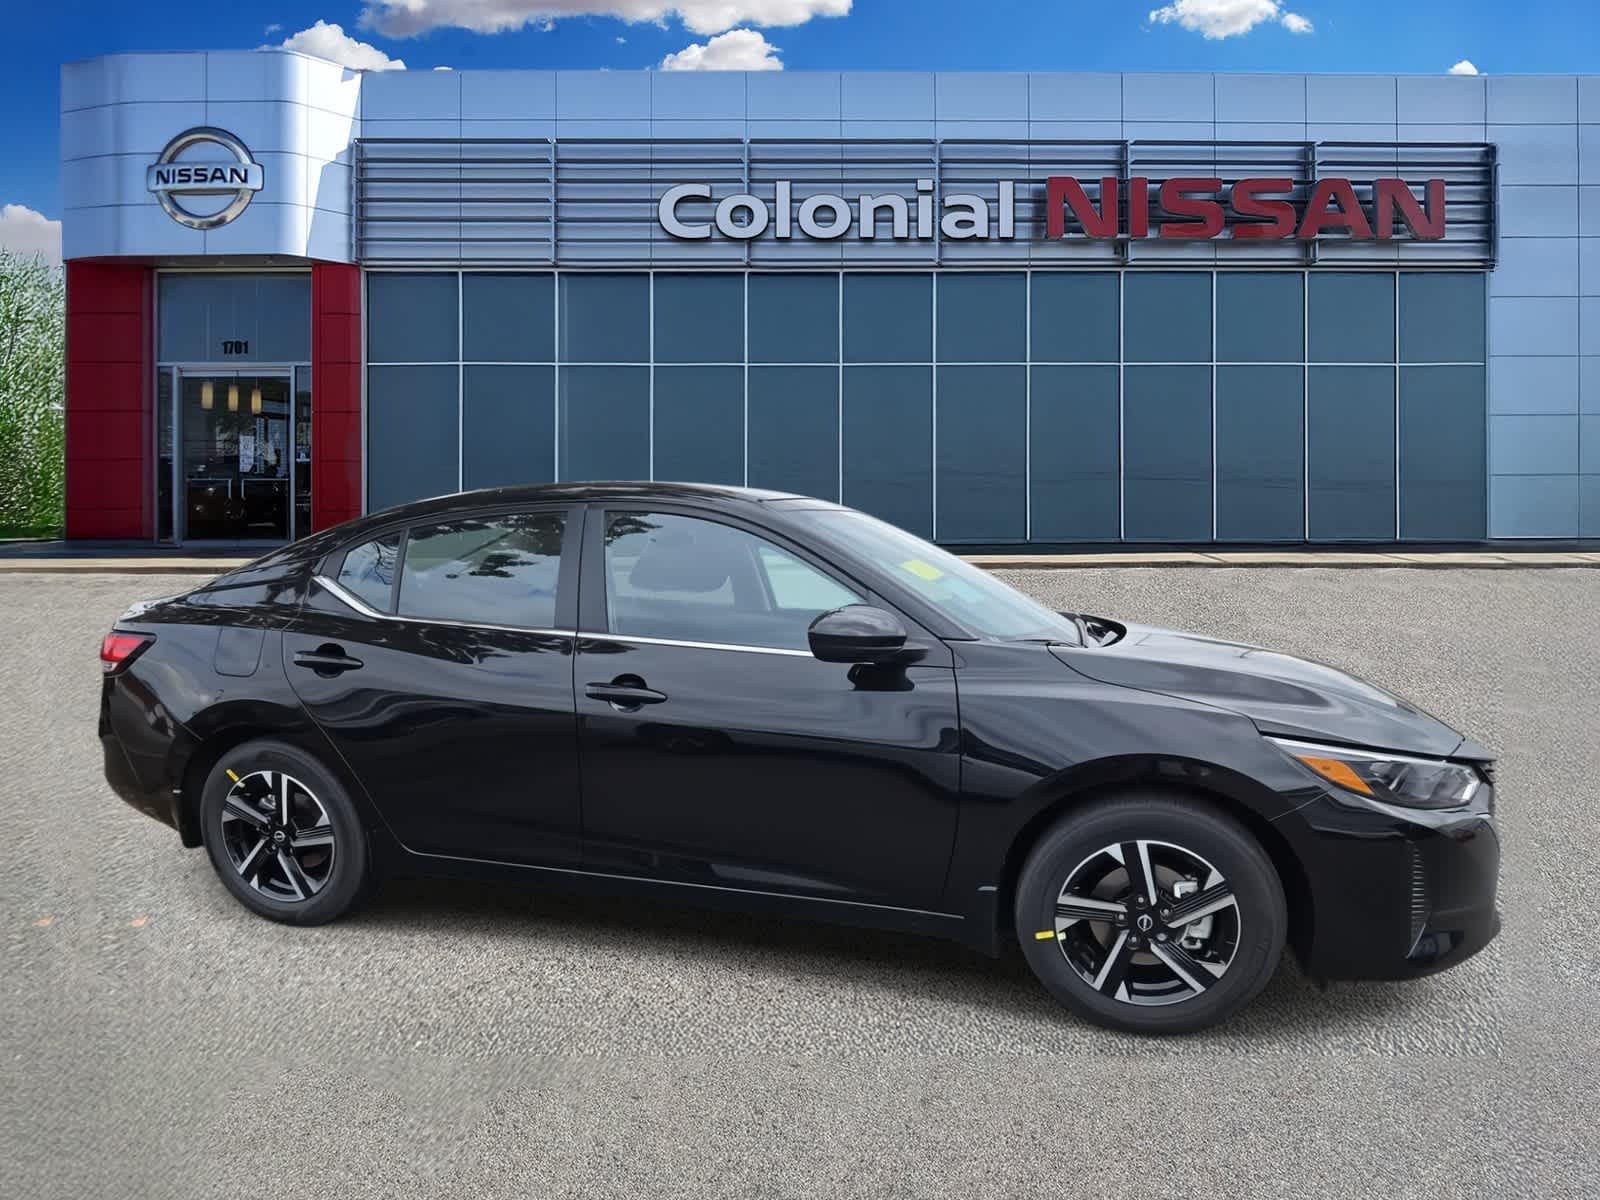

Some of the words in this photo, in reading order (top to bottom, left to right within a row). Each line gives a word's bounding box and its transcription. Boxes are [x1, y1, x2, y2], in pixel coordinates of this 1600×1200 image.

[155, 167, 249, 185] NISSAN
[658, 180, 1015, 240] Colonial
[1045, 176, 1446, 241] NISSAN
[222, 340, 249, 354] 1701
